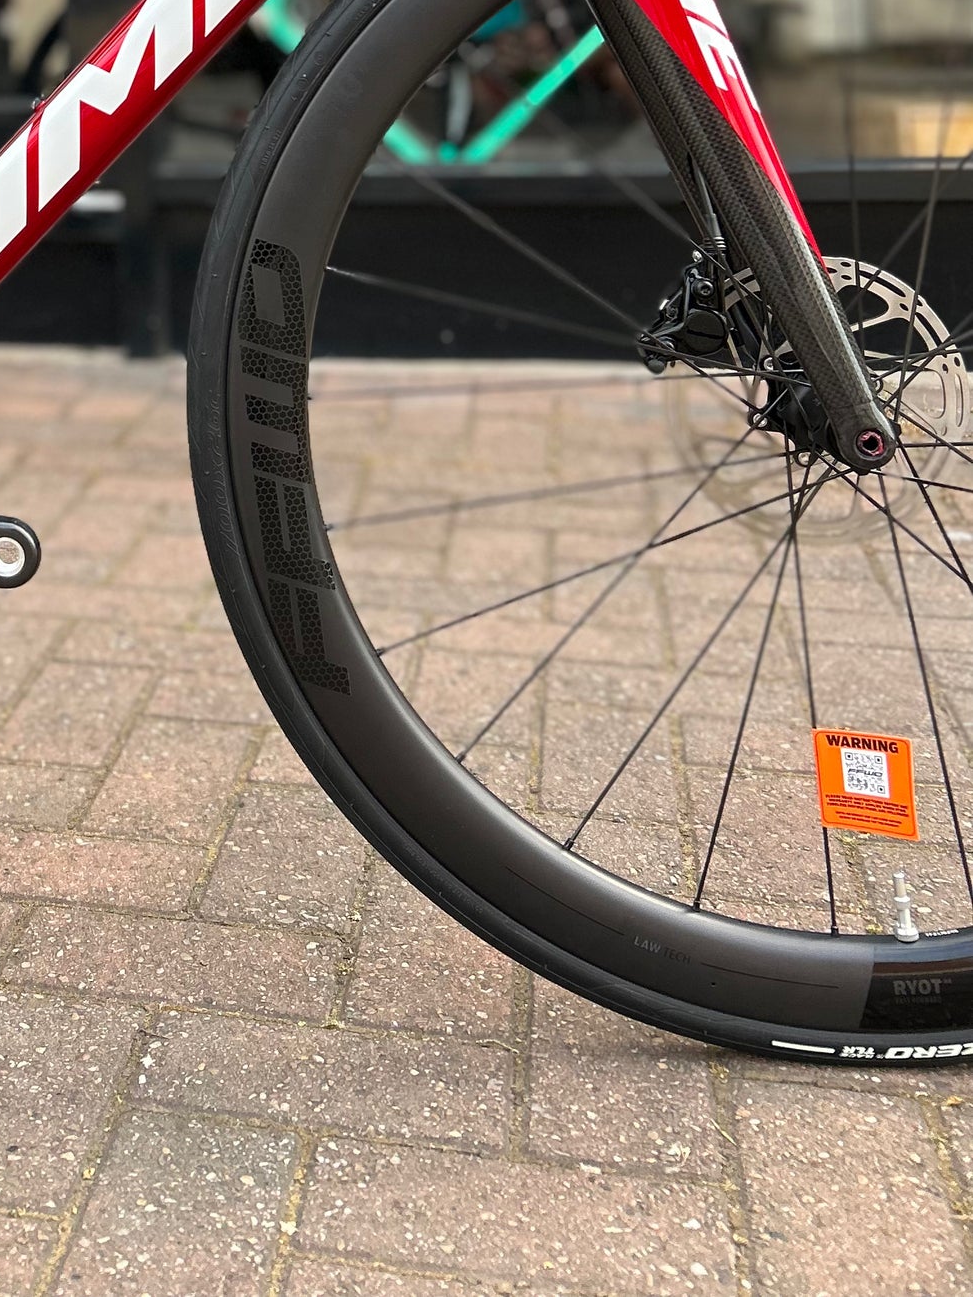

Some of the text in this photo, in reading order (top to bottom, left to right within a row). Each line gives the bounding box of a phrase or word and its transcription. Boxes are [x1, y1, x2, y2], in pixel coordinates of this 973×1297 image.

[238, 238, 352, 696] FFWD
[826, 734, 899, 754] WARNING
[633, 935, 692, 964] LAW TECH
